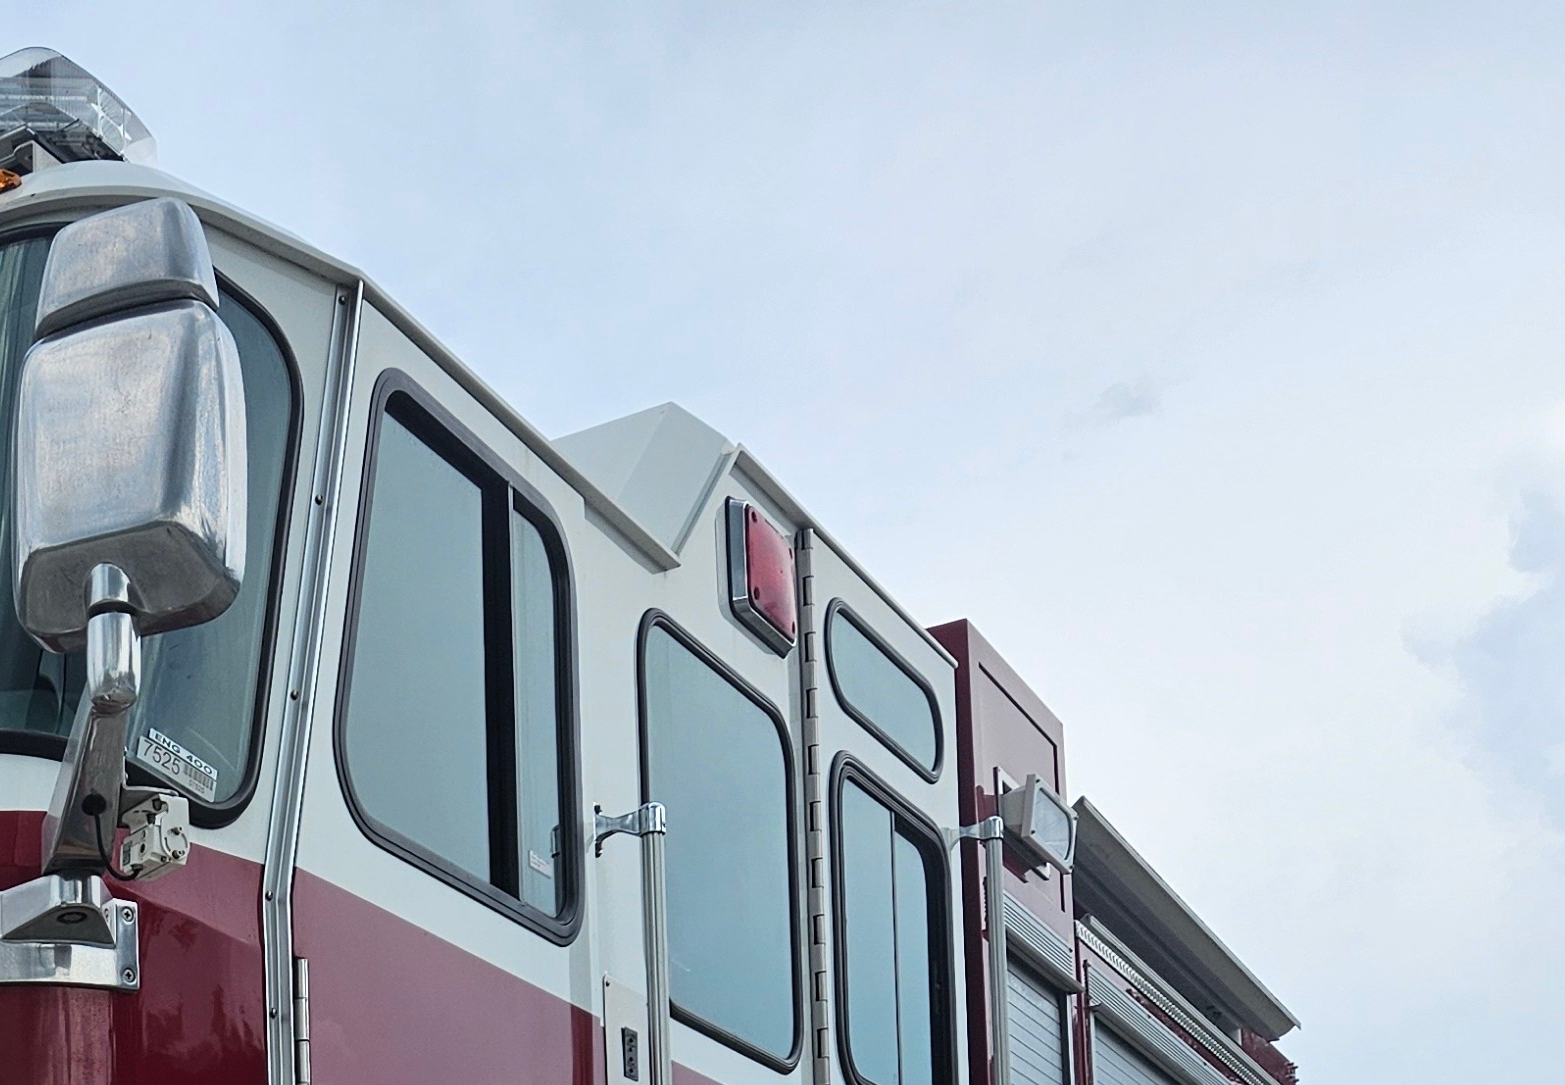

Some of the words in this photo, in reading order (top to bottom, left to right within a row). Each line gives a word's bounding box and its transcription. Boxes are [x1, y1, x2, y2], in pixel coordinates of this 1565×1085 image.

[143, 739, 181, 775] 7525
[154, 732, 181, 754] ENG
[186, 755, 213, 775] 400
